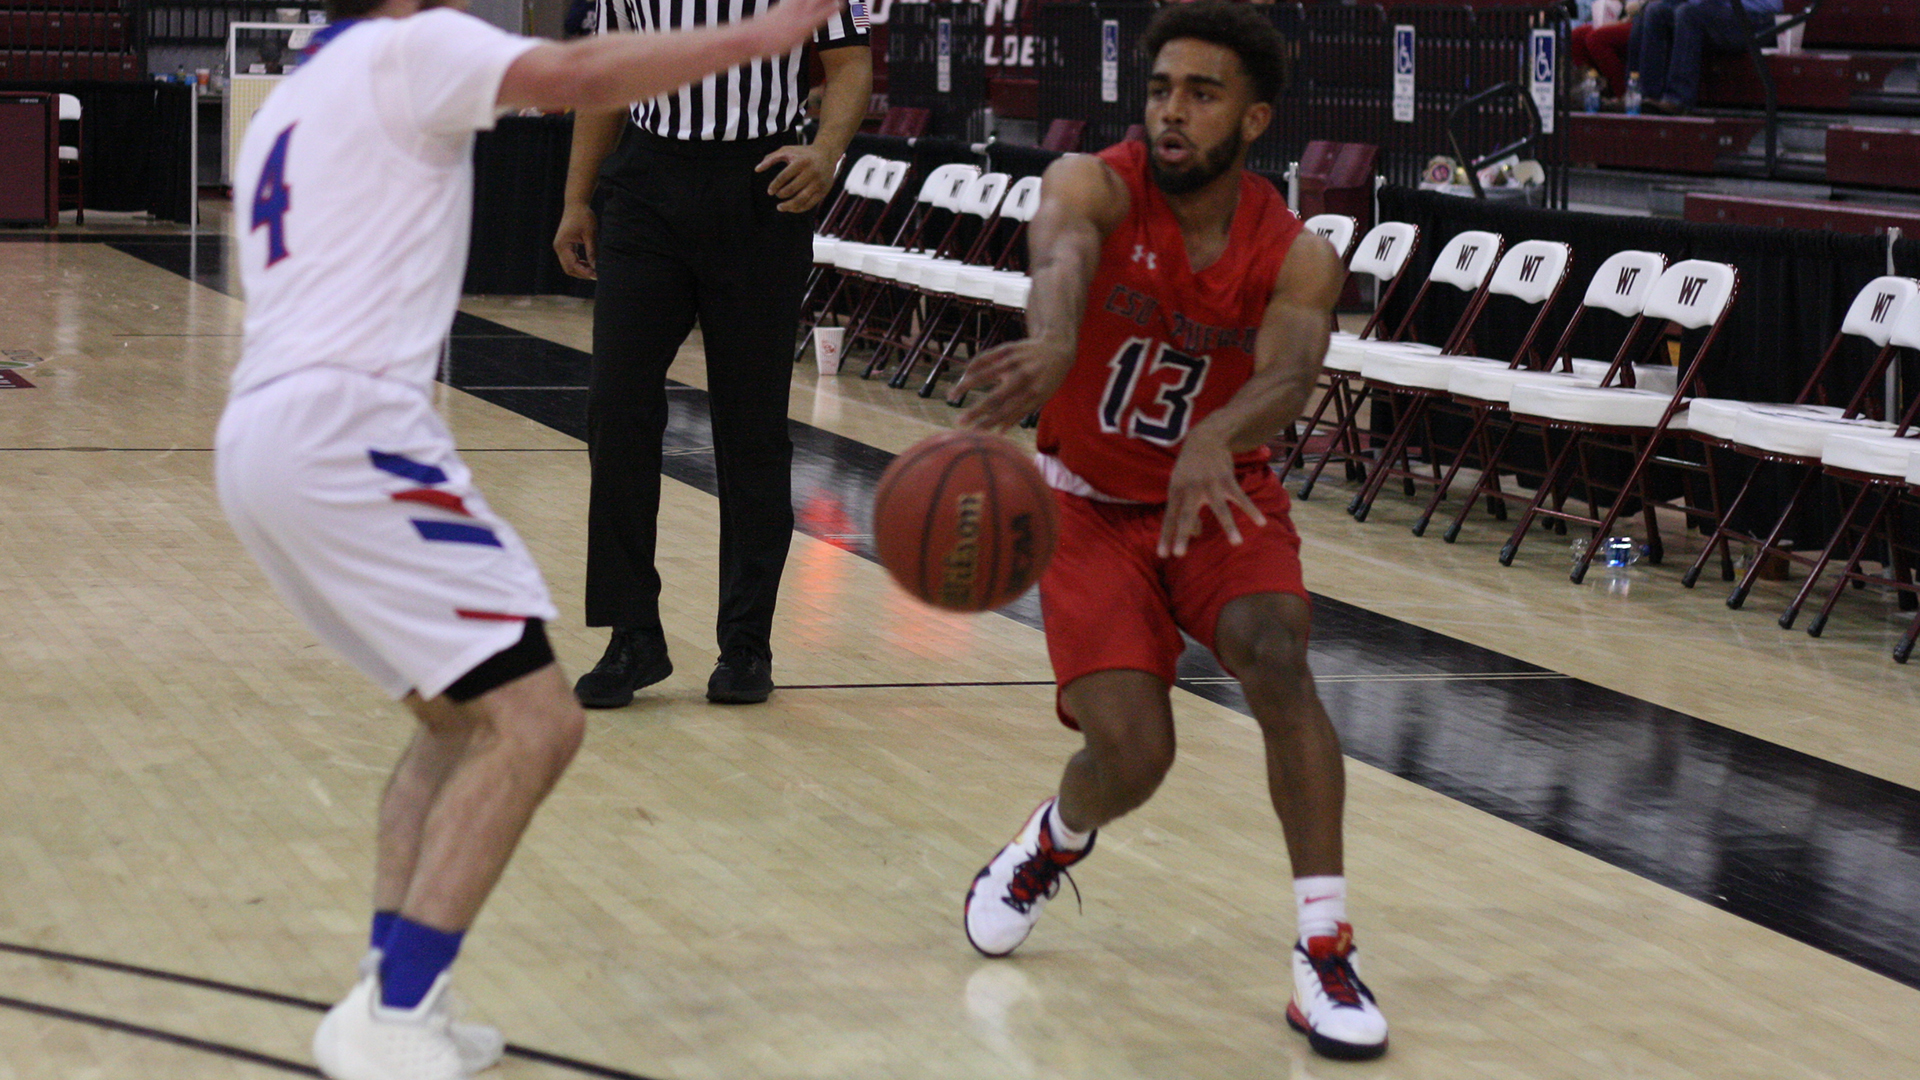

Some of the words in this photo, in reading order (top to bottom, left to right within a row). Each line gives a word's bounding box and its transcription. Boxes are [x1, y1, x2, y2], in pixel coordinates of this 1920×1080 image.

[250, 119, 299, 269] 4
[1374, 235, 1396, 261] WT
[1455, 244, 1478, 271] WT
[1519, 254, 1545, 282] WT
[1614, 266, 1641, 295] WT
[1677, 275, 1708, 306] WT
[1870, 292, 1896, 324] WT
[1098, 337, 1212, 447] 13
